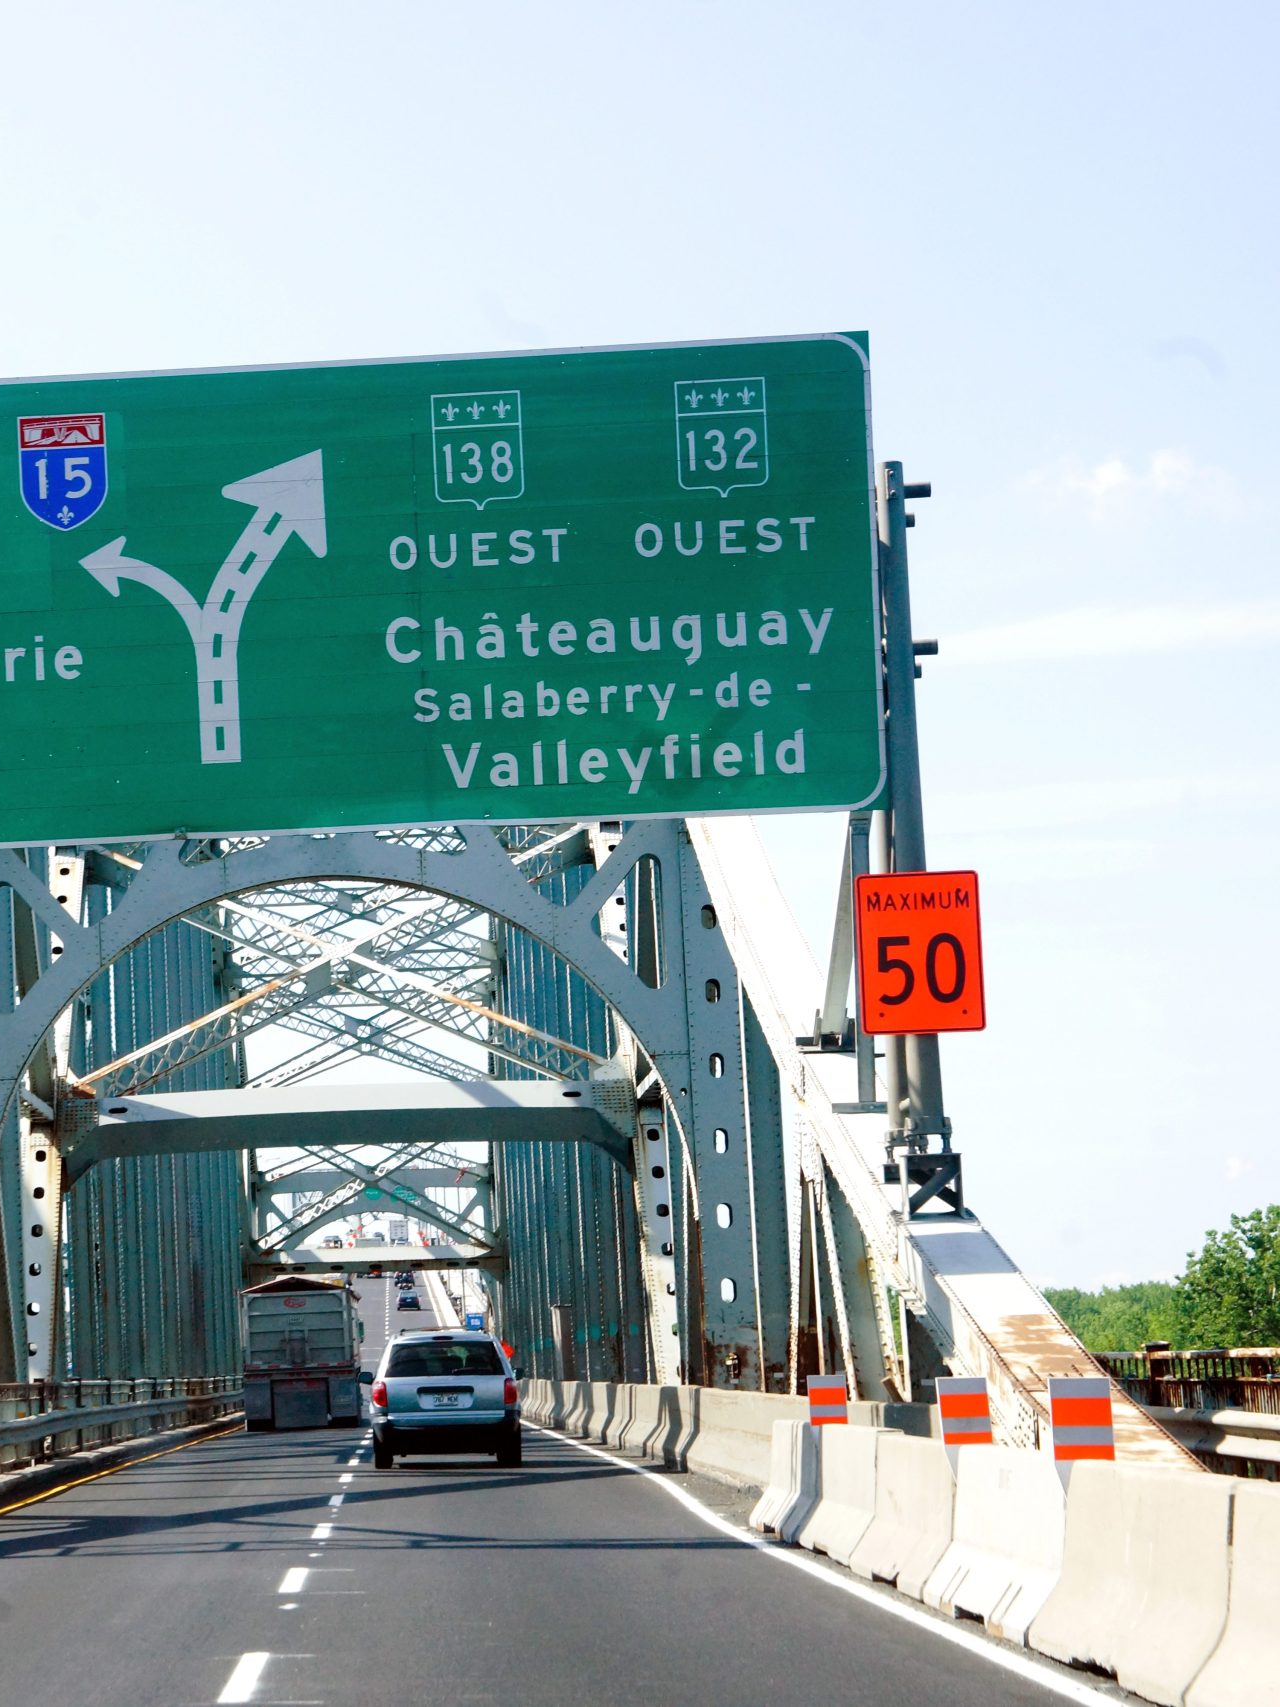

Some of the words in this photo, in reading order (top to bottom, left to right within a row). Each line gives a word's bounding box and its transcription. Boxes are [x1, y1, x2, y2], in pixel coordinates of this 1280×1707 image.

[443, 441, 514, 484] 138
[687, 428, 758, 471] 132
[35, 457, 92, 500] 15
[389, 528, 568, 570] OUEST
[635, 516, 816, 557] OUEST
[385, 607, 834, 666] Châteauguay
[442, 728, 807, 794] Valleyfield
[866, 888, 970, 912] MAXIMUM
[877, 932, 966, 1006] 50
